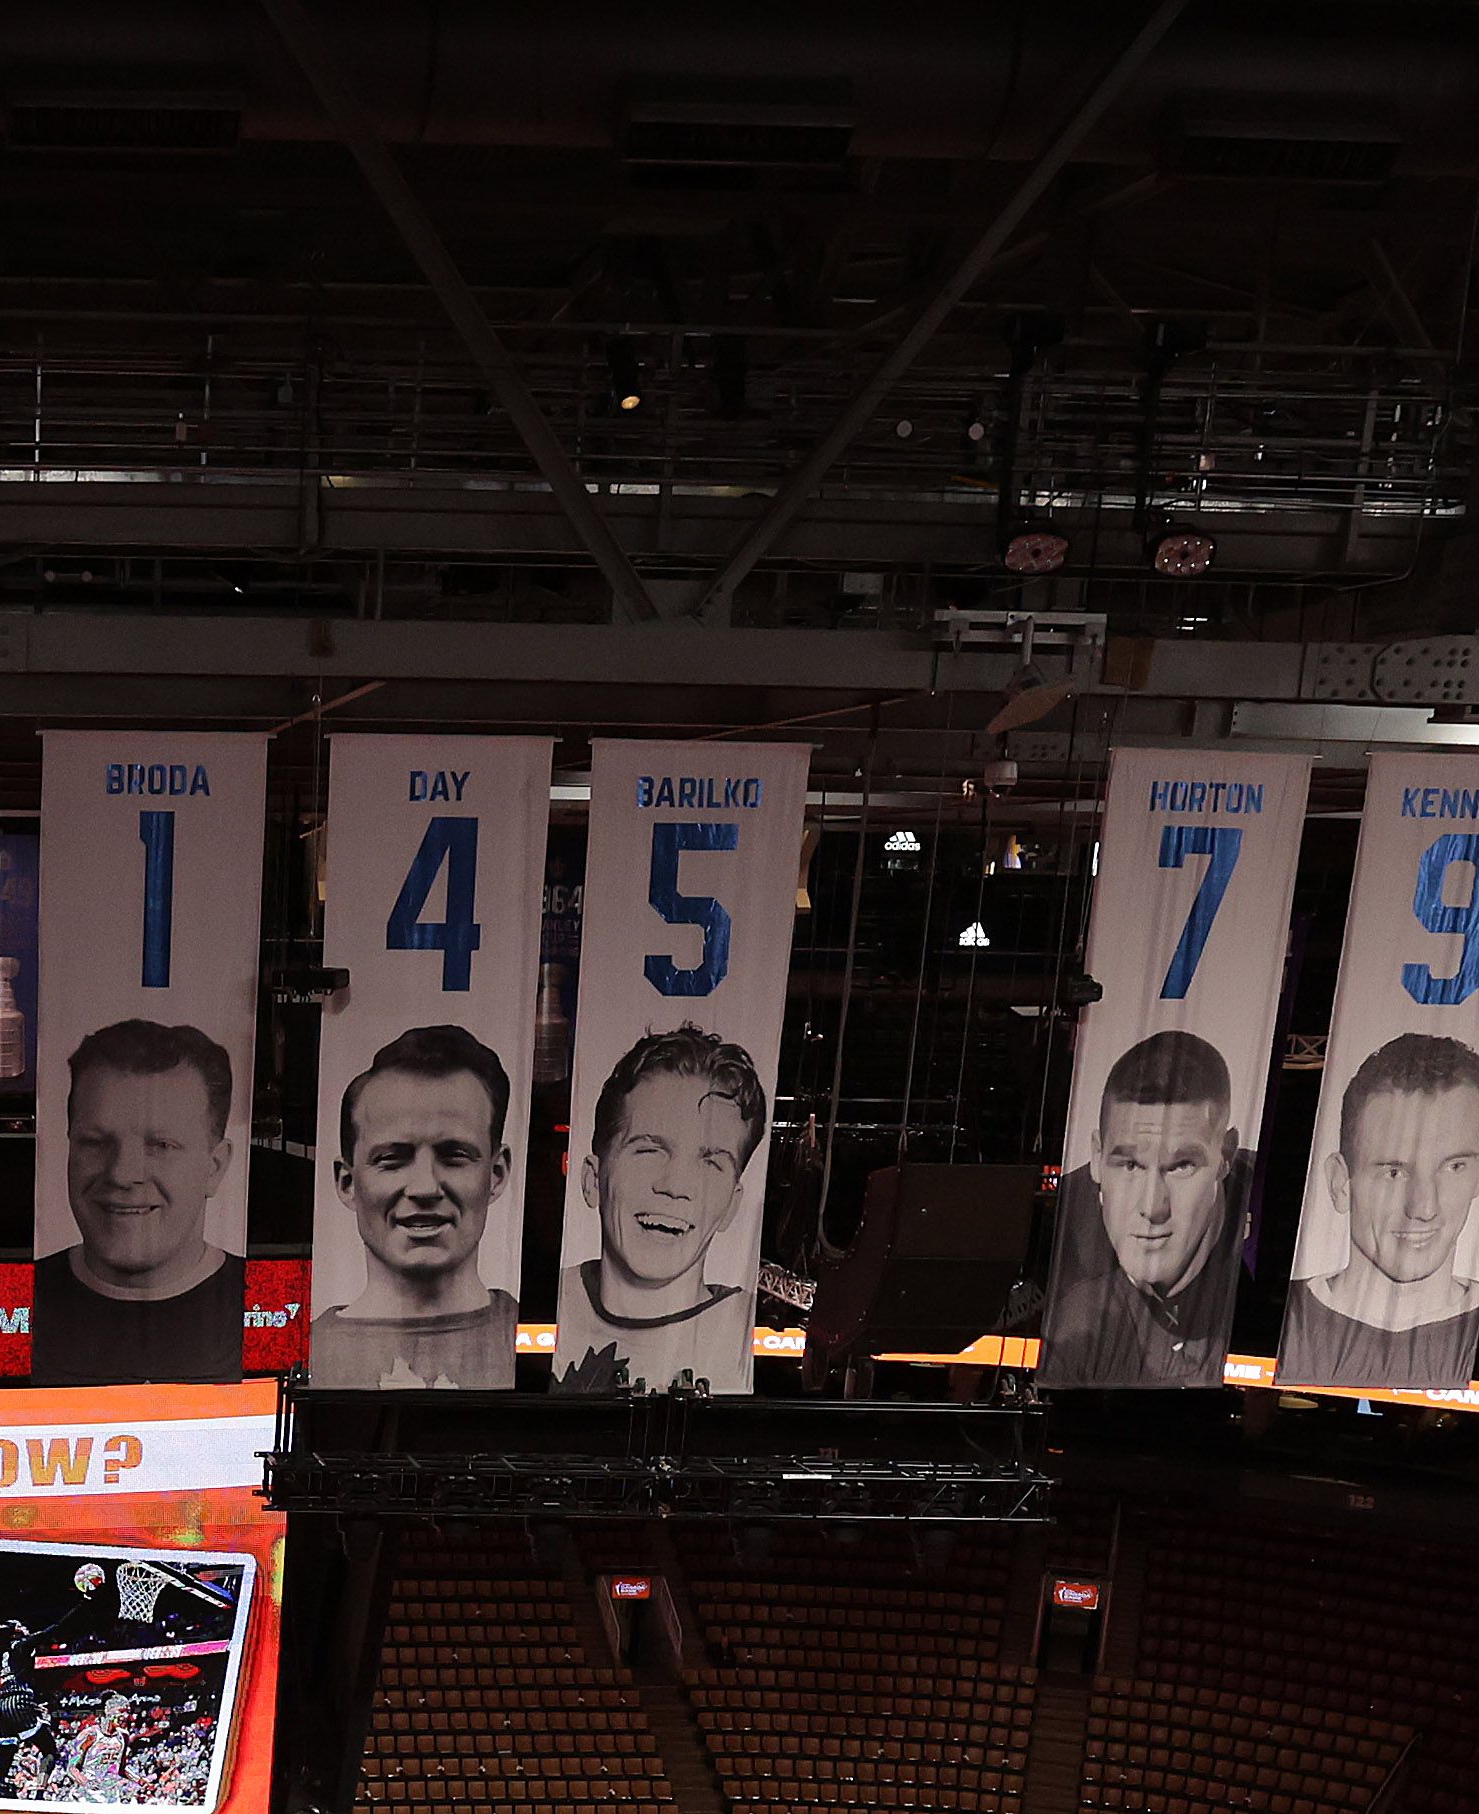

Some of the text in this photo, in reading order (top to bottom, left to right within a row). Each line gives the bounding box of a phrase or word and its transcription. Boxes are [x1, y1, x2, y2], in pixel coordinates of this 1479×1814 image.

[106, 763, 211, 797] BRODA
[409, 770, 471, 803] DAY
[637, 776, 763, 809] BARILKO
[1149, 780, 1263, 814] HORTON
[138, 810, 175, 988] 1
[386, 816, 480, 992] 4
[643, 823, 739, 997] 5
[1158, 825, 1242, 1000] 7
[1224, 1364, 1262, 1379] ME
